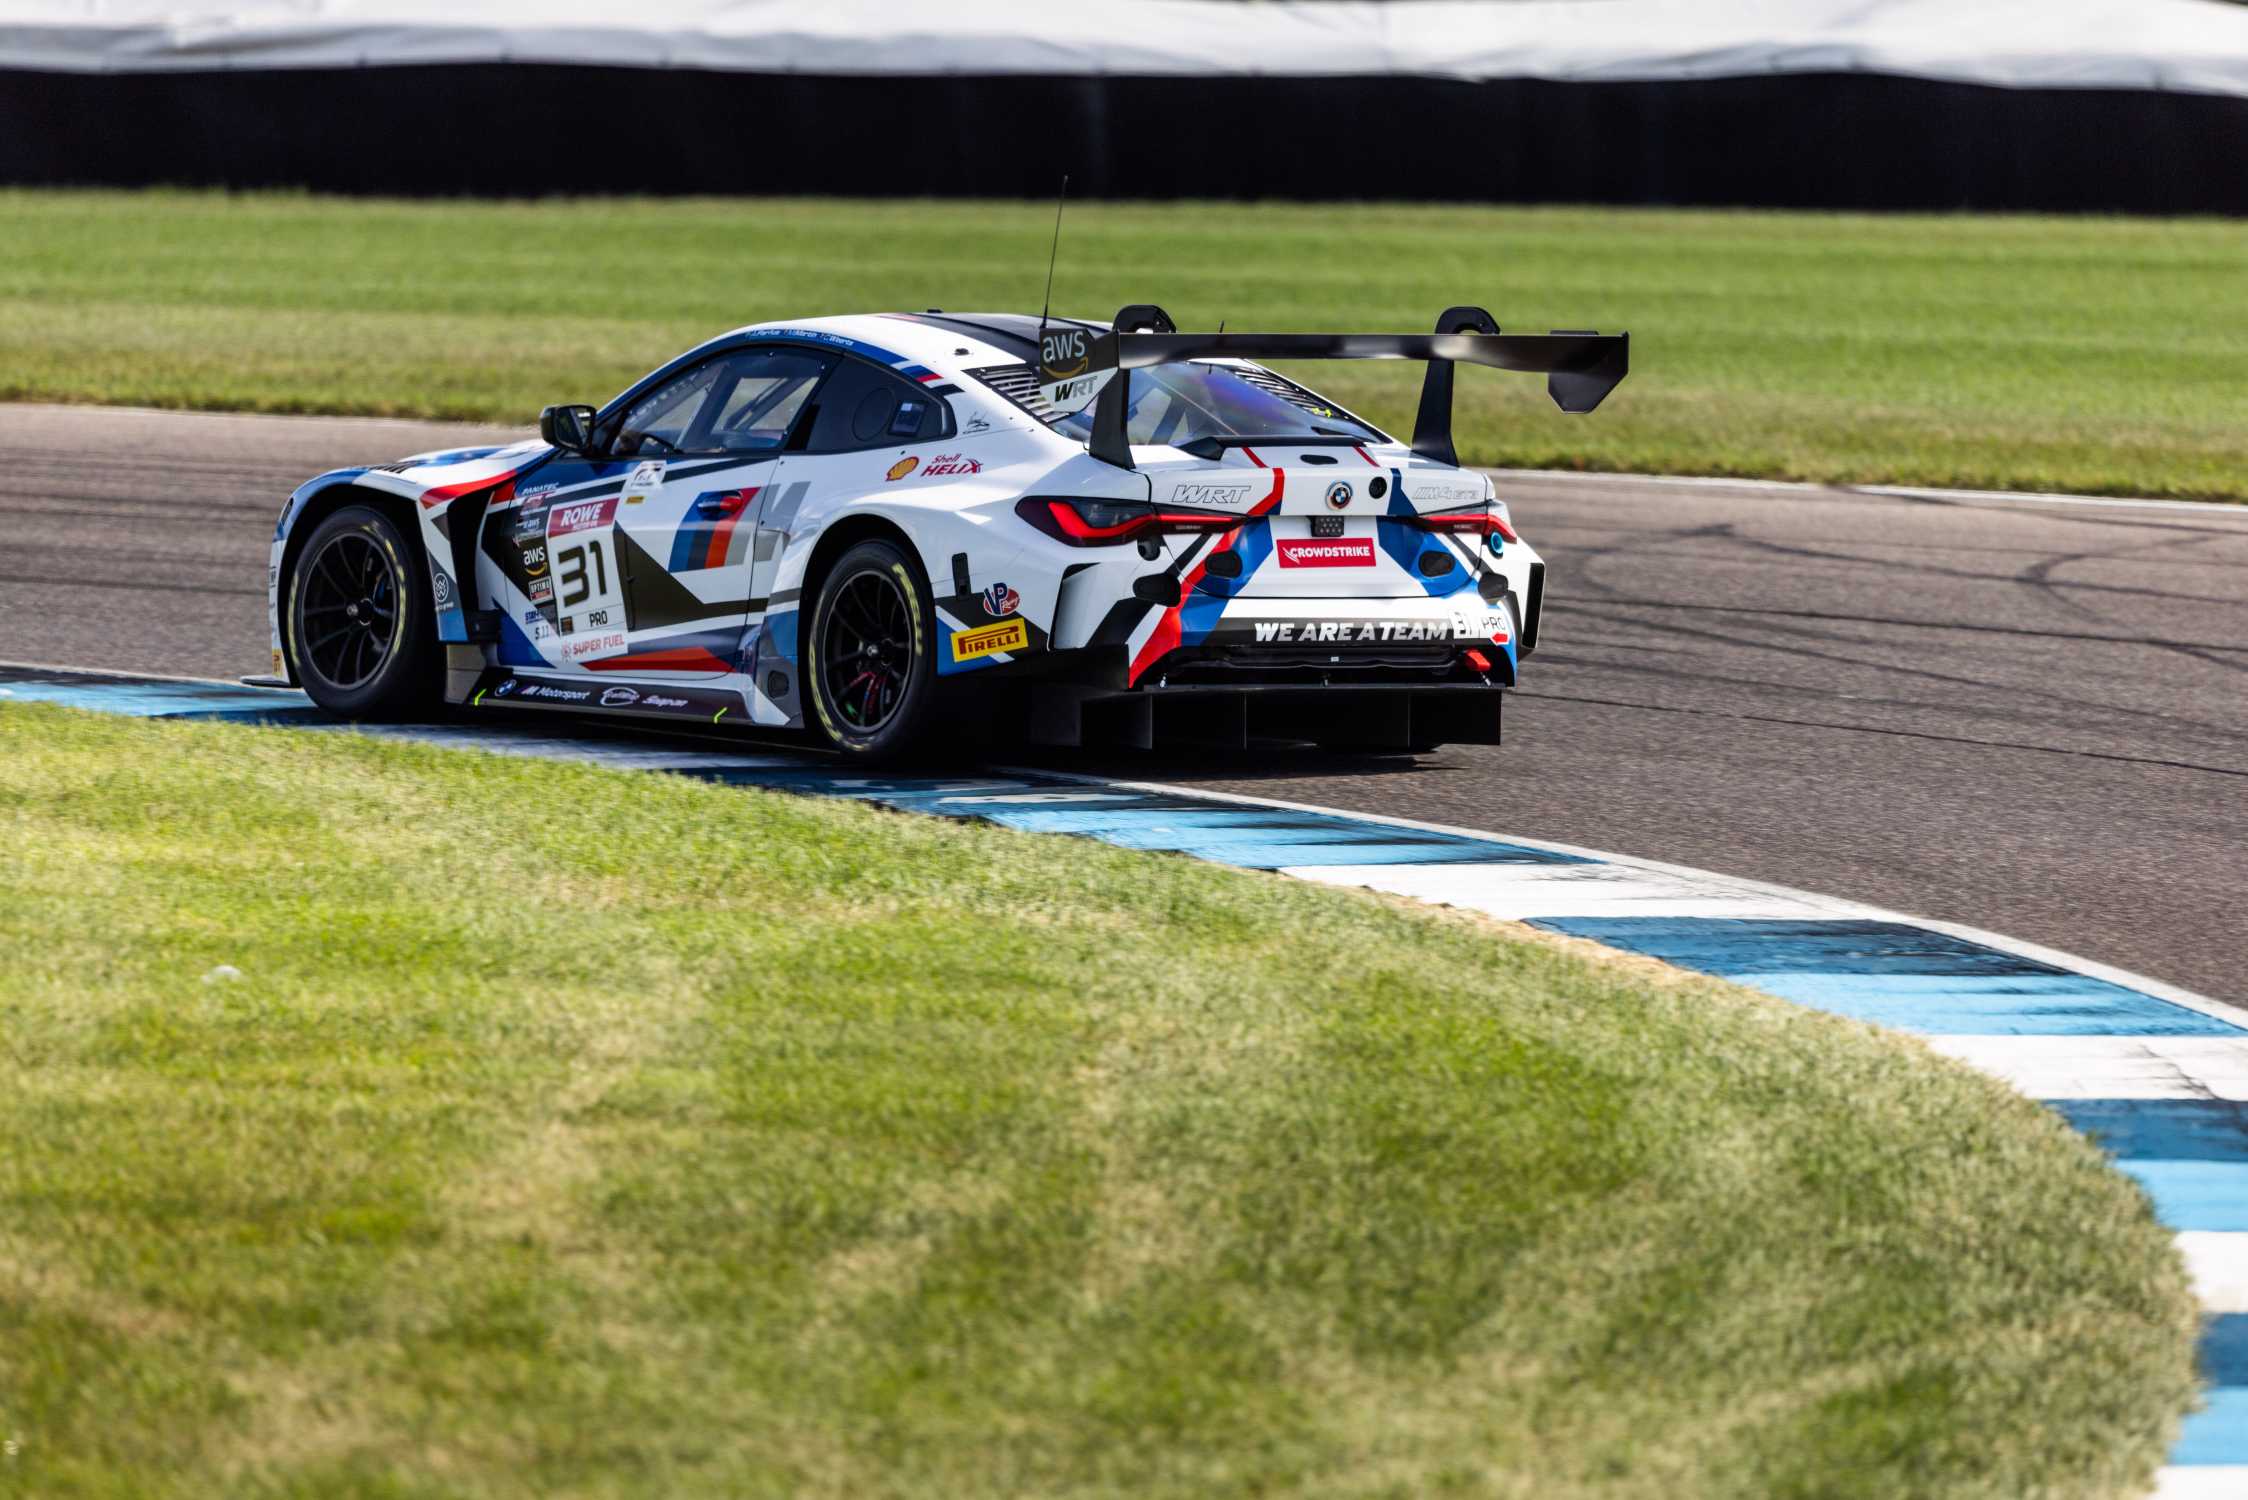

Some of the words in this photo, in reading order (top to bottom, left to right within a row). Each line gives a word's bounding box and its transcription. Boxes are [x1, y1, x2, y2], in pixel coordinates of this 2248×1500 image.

[1043, 331, 1085, 363] aws
[1055, 376, 1097, 402] WRT
[920, 459, 983, 476] HELIX
[931, 453, 962, 464] Shell
[1172, 485, 1251, 503] WRT
[561, 503, 604, 527] ROWE
[523, 546, 546, 565] aws
[1290, 546, 1371, 559] CROWDSTRIKE
[558, 540, 608, 608] 31
[984, 583, 1008, 615] VP
[589, 610, 608, 627] PRO
[958, 625, 1020, 655] PIRELLI
[1254, 622, 1296, 642] WE
[1298, 622, 1353, 642] ARE
[1380, 620, 1448, 641] TEAM
[573, 639, 602, 655] SUPER
[603, 634, 625, 649] FUEL
